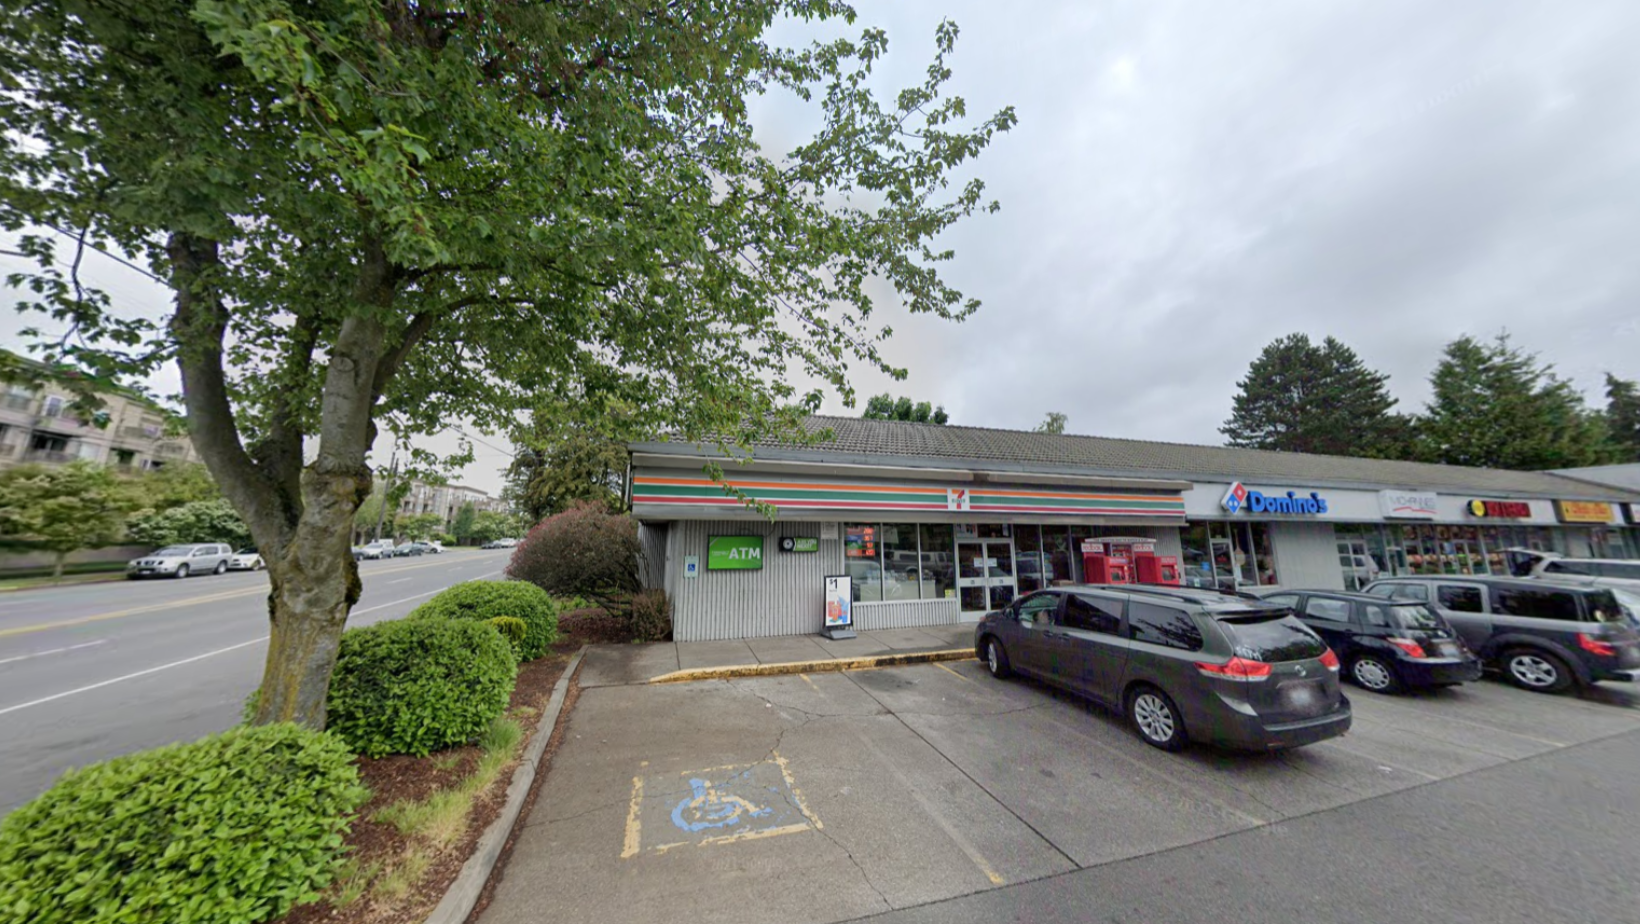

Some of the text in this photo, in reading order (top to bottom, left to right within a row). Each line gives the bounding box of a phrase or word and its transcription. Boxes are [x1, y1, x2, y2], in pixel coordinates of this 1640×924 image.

[1248, 490, 1327, 513] Domino's
[729, 547, 760, 560] ATM
[829, 578, 838, 589] $1
